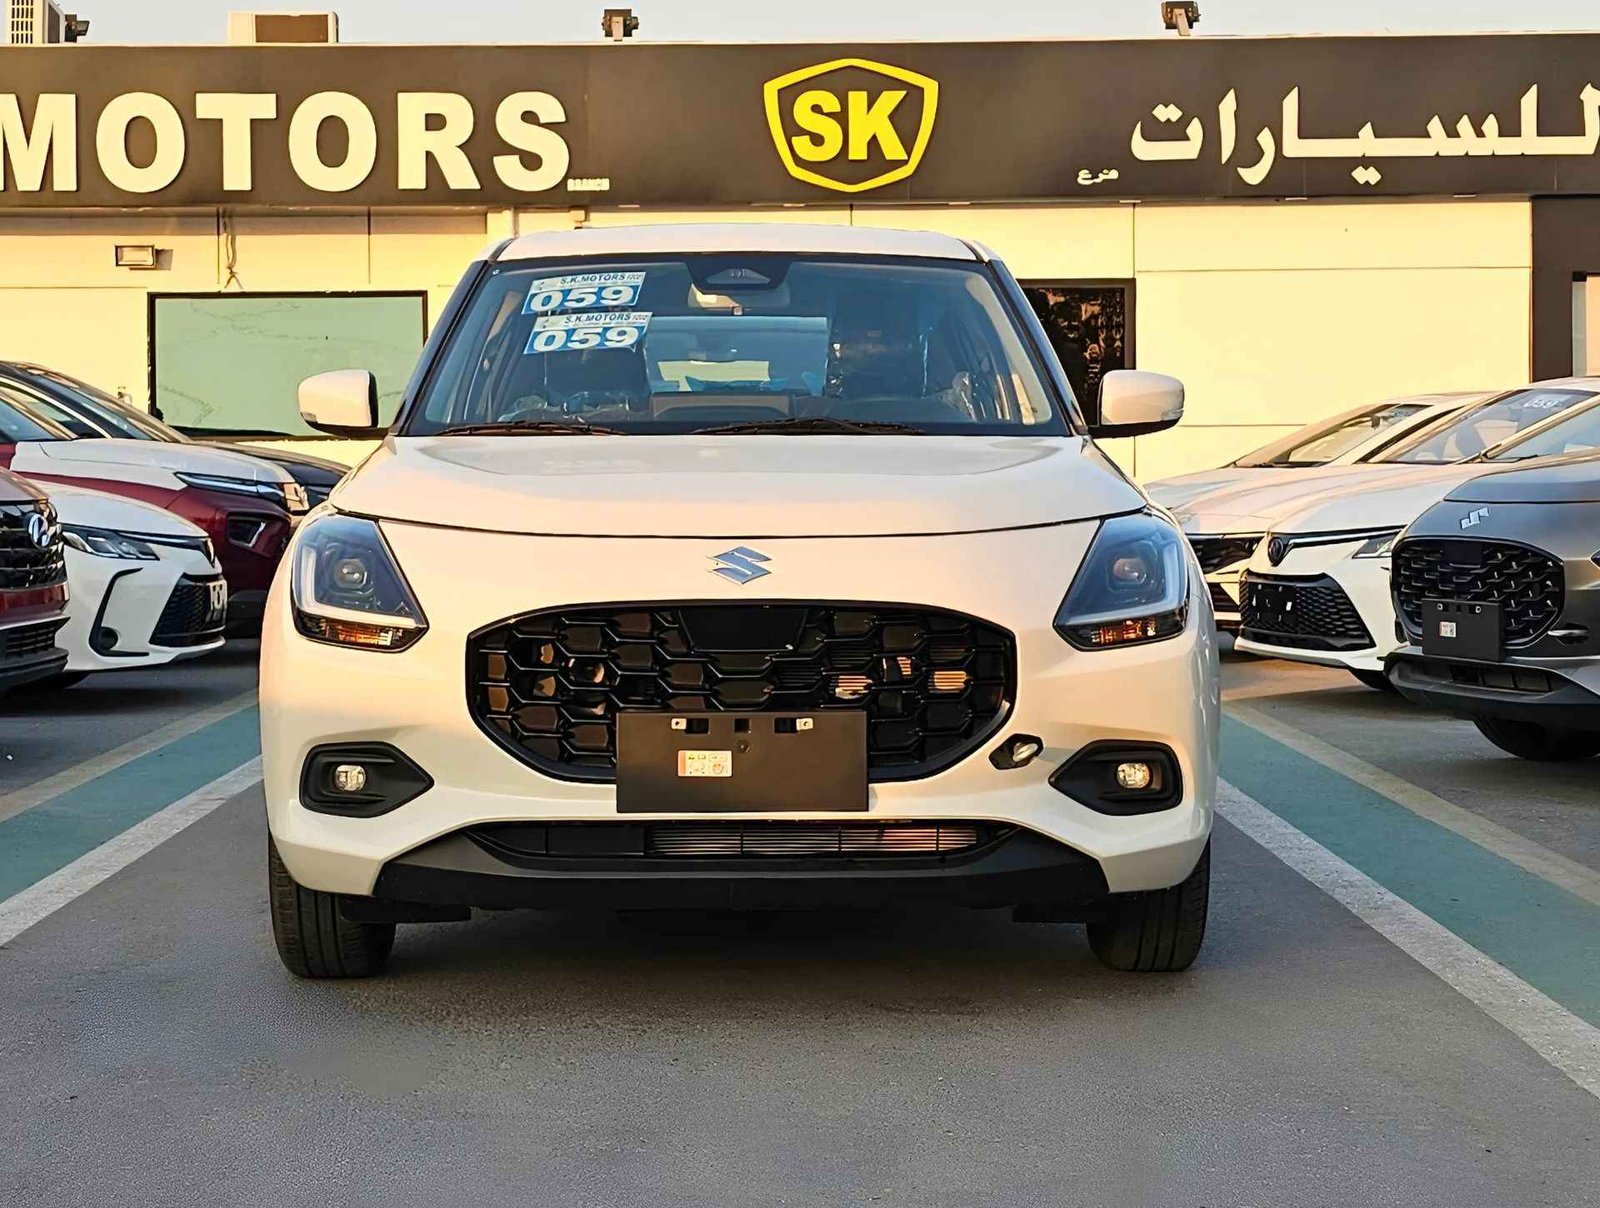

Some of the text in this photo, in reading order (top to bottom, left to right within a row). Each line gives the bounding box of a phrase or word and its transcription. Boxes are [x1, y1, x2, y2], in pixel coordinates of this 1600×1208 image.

[0, 91, 570, 193] MOTORS
[791, 89, 909, 162] SK
[530, 285, 634, 312] 059
[533, 326, 639, 352] 059
